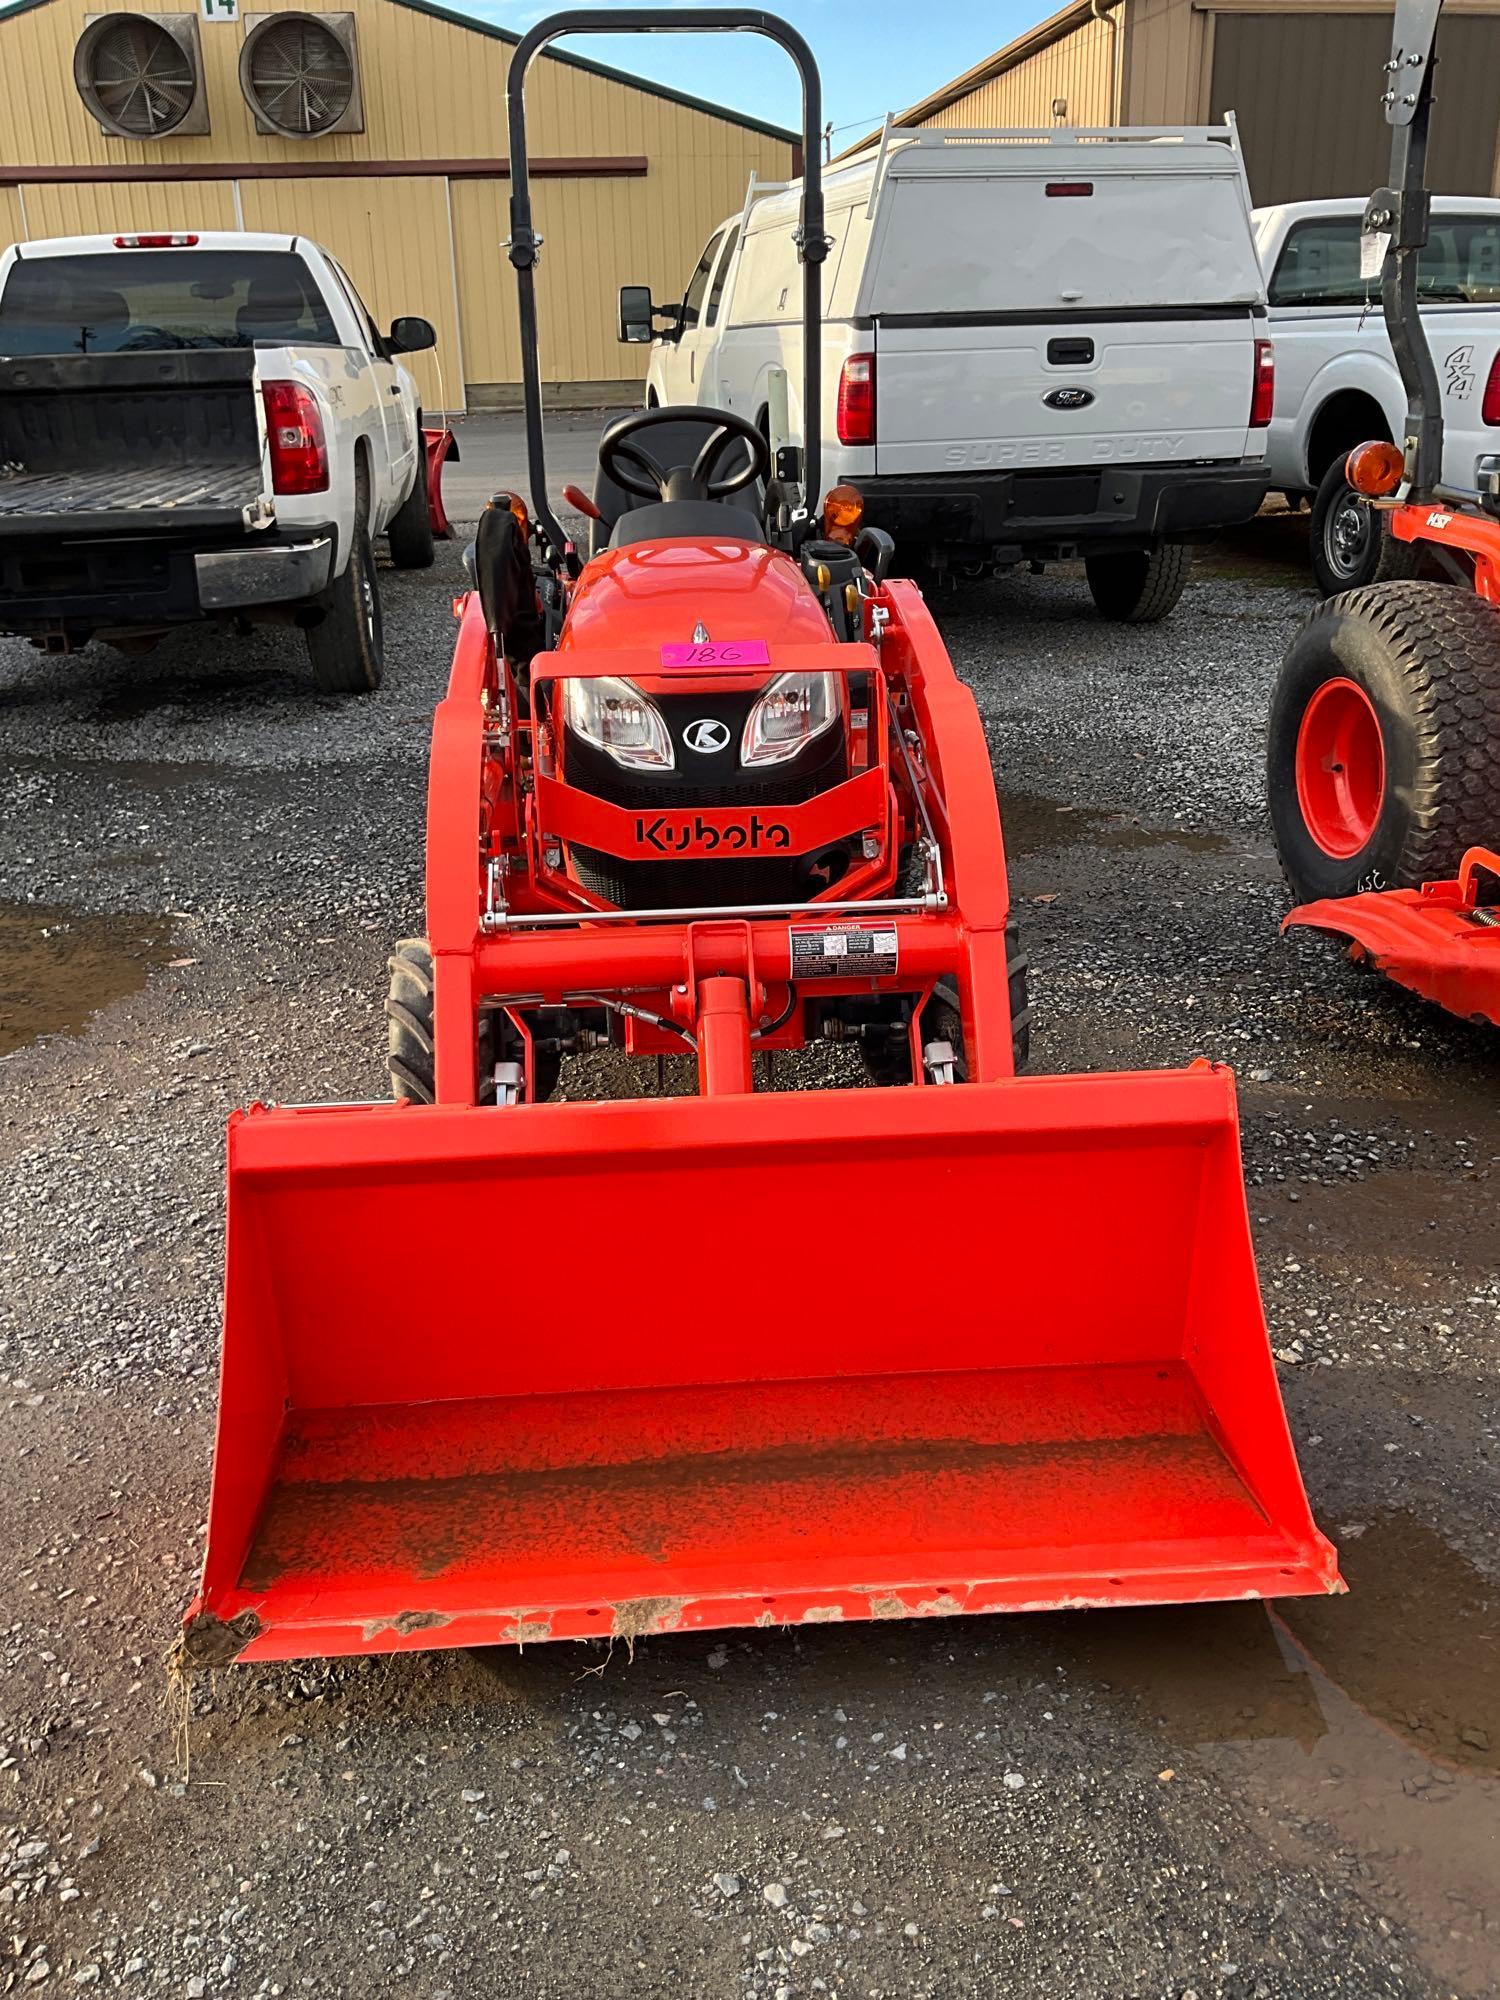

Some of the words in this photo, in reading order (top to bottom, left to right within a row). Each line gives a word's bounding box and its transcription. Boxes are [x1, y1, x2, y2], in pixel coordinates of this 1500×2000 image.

[1055, 390, 1086, 405] Ford
[945, 441, 1066, 466] SUPER
[1091, 435, 1185, 460] DUTY
[636, 815, 790, 851] Kubota
[832, 924, 861, 932] DANGER
